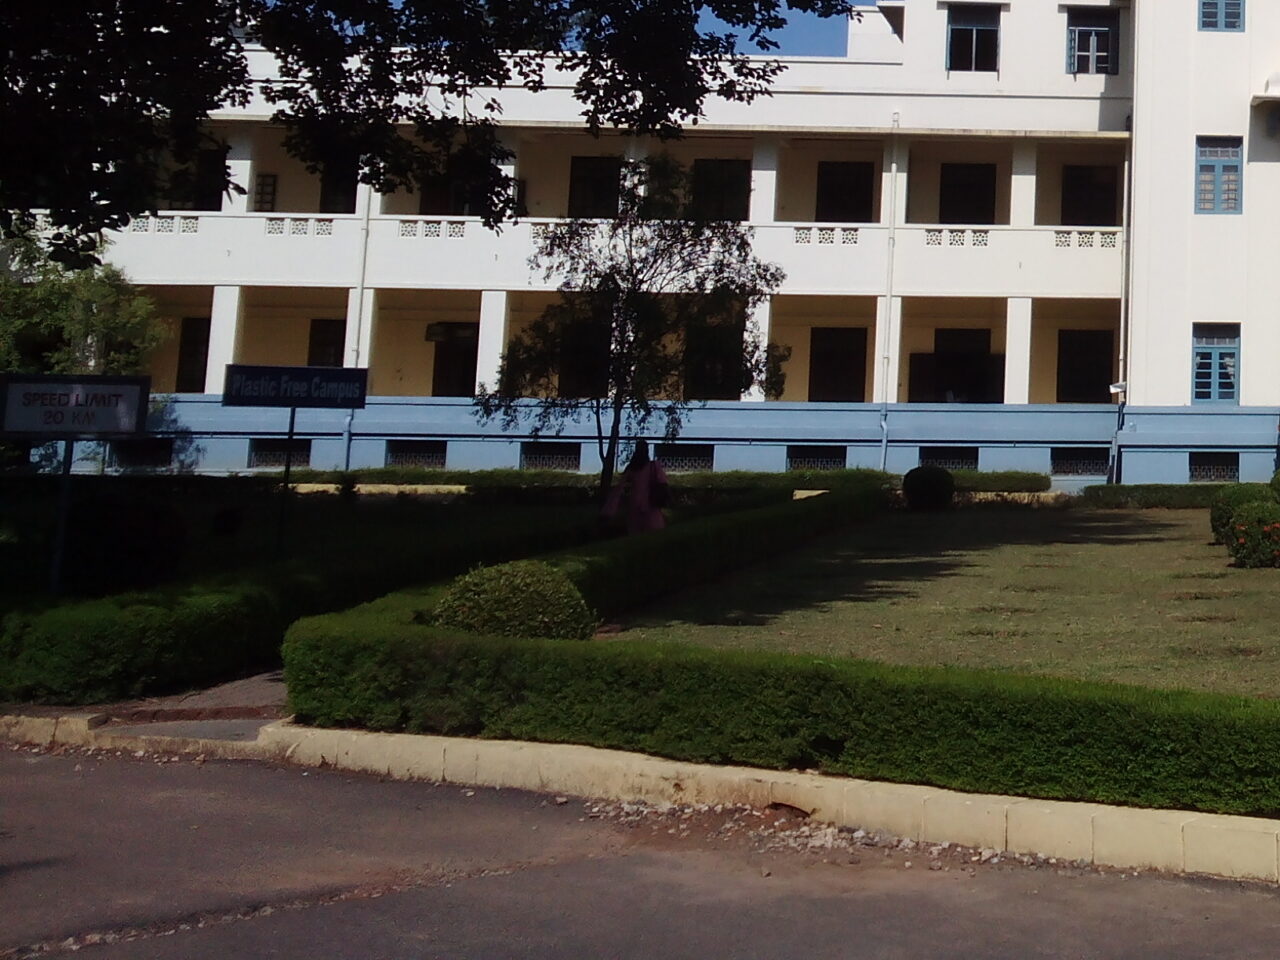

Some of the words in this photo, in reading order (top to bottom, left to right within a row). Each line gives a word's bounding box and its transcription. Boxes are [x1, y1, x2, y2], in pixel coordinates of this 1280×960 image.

[231, 373, 277, 397] Plastic
[279, 375, 308, 397] Free
[311, 376, 360, 402] Campus
[22, 392, 70, 408] SPEED
[74, 393, 122, 409] LIMIT
[43, 409, 65, 426] 20
[72, 411, 96, 426] KM
